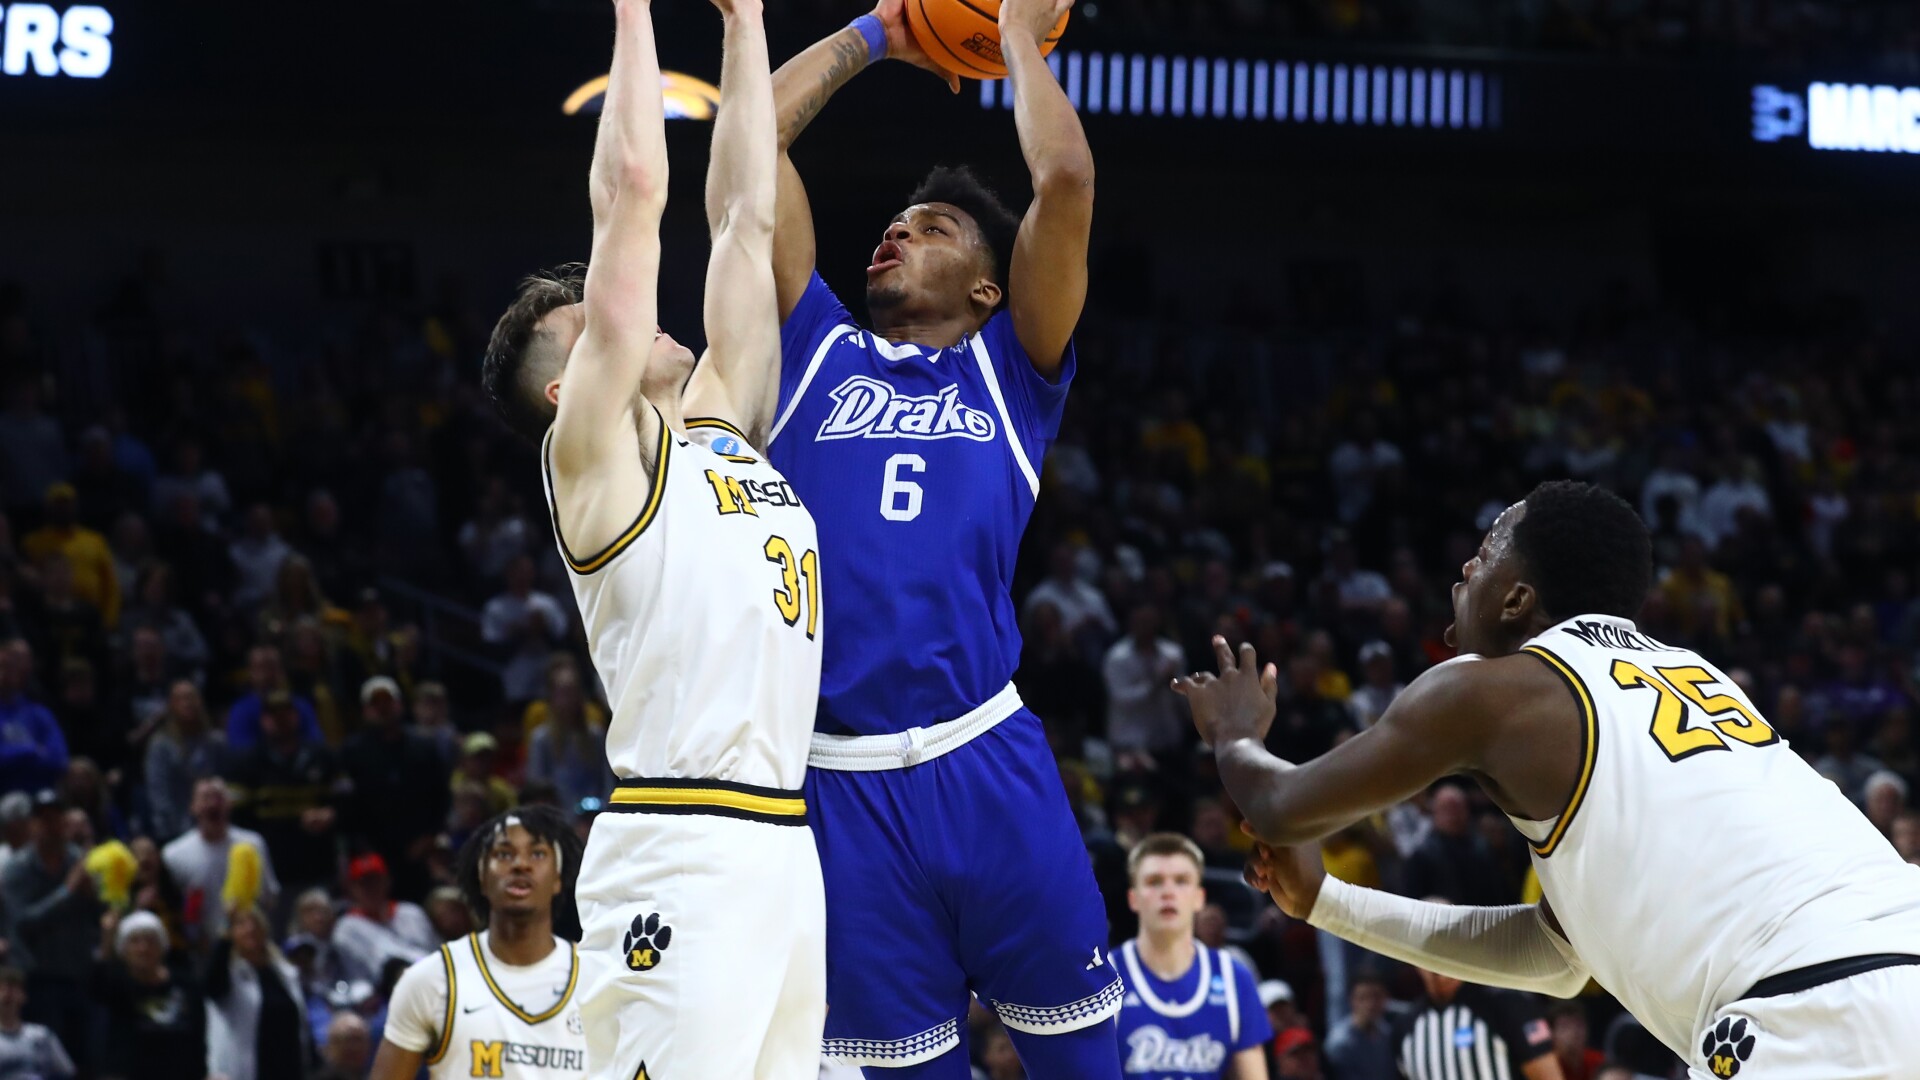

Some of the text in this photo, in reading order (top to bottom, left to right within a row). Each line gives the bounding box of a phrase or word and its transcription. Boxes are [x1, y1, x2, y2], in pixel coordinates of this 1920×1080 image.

[0, 2, 114, 79] RS
[815, 374, 996, 442] Drake
[879, 453, 927, 522] 6
[763, 534, 818, 642] 31
[1609, 658, 1781, 763] 25
[631, 948, 653, 967] M
[470, 1039, 583, 1079] MISSOURI
[1713, 1054, 1734, 1076] M
